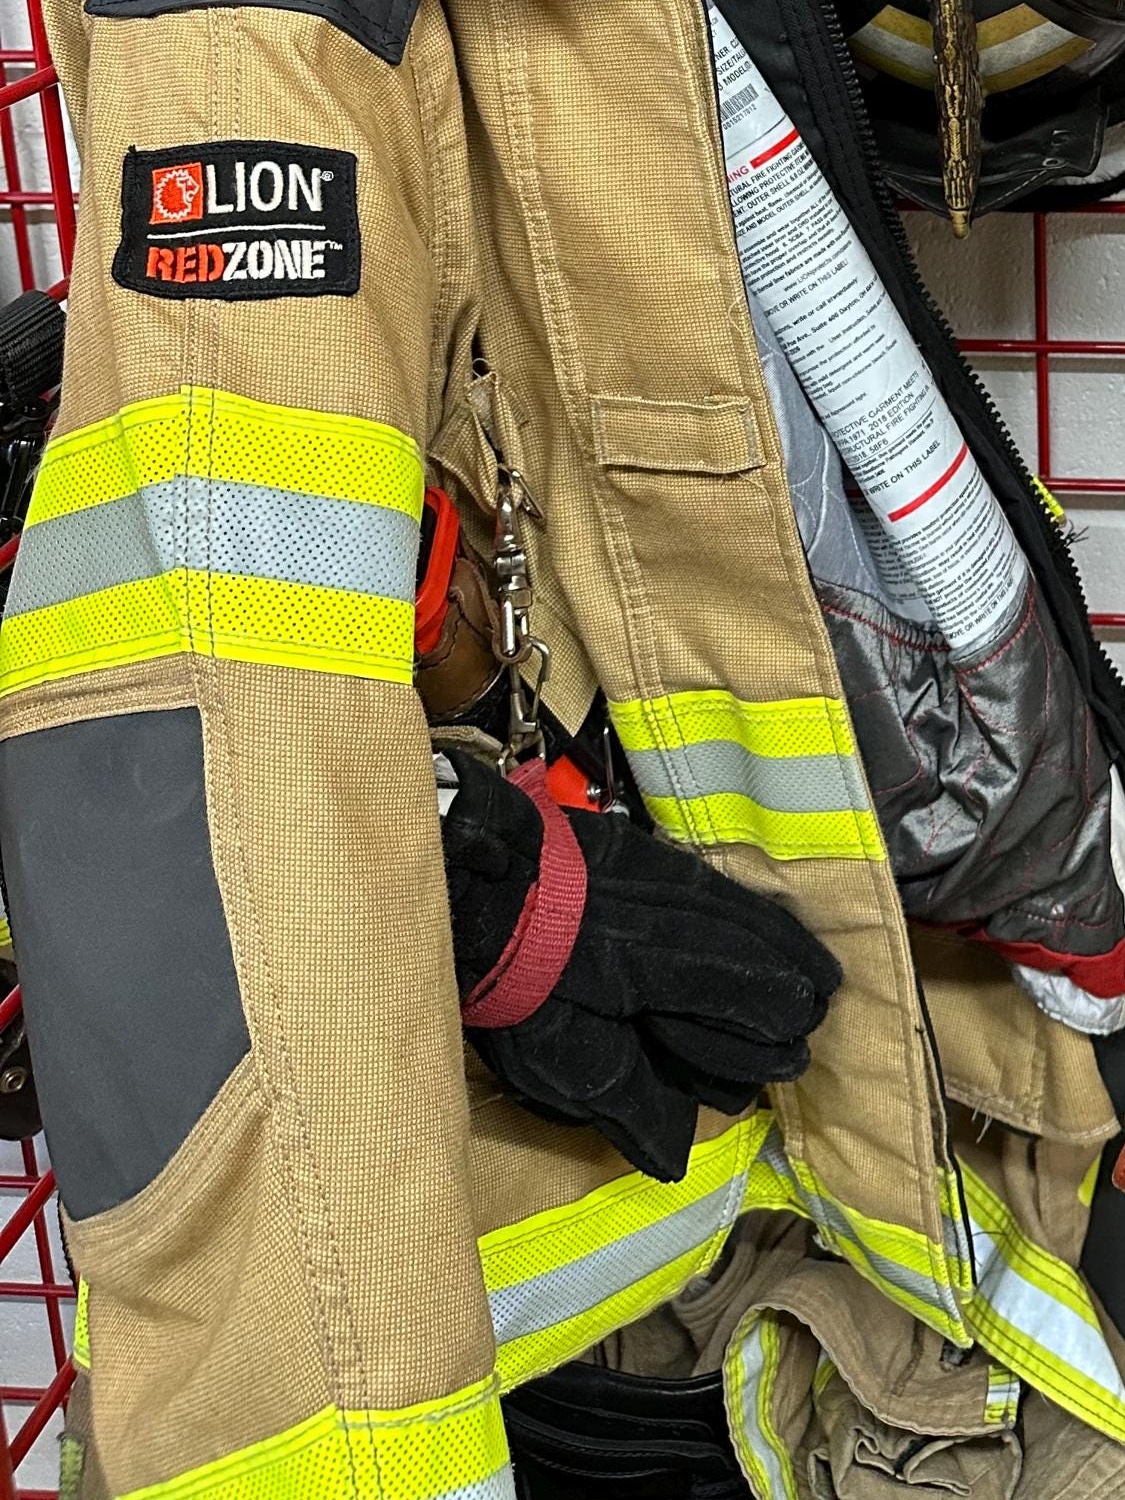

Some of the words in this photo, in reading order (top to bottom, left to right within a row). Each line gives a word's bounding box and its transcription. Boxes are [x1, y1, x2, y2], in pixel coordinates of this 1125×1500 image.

[725, 164, 749, 183] ING
[727, 179, 751, 197] TURAL
[750, 169, 766, 183] FIRE
[765, 152, 792, 173] FIGHTING
[729, 186, 759, 208] LLOWING
[759, 161, 795, 190] PROTECTIVE
[746, 191, 769, 209] OUTER
[769, 178, 790, 194] SHELL
[744, 221, 757, 231] AND
[756, 209, 776, 224] MODEL
[775, 196, 794, 213] OUTER
[765, 230, 776, 239] and
[789, 208, 810, 225] together
[786, 226, 797, 235] and
[759, 261, 785, 279] protection
[785, 254, 796, 263] and
[796, 240, 817, 256] restricts
[769, 250, 787, 264] proper
[807, 230, 817, 240] and
[778, 299, 788, 309] OR
[787, 287, 808, 304] WRITE
[807, 280, 818, 291] ON
[816, 270, 831, 284] THIS
[814, 300, 827, 311] call
[810, 319, 827, 333] Suite
[852, 351, 862, 361] and
[831, 414, 868, 439] OTECTIVE
[866, 387, 903, 419] GARMENT
[902, 370, 919, 390] MEETS
[867, 413, 887, 431] 2018
[886, 390, 914, 417] EDITION
[884, 413, 904, 430] FIRE
[902, 387, 928, 417] FIGHTING
[889, 470, 904, 484] ON
[904, 457, 921, 473] THIS
[963, 620, 975, 631] OR
[973, 606, 992, 624] WRITE
